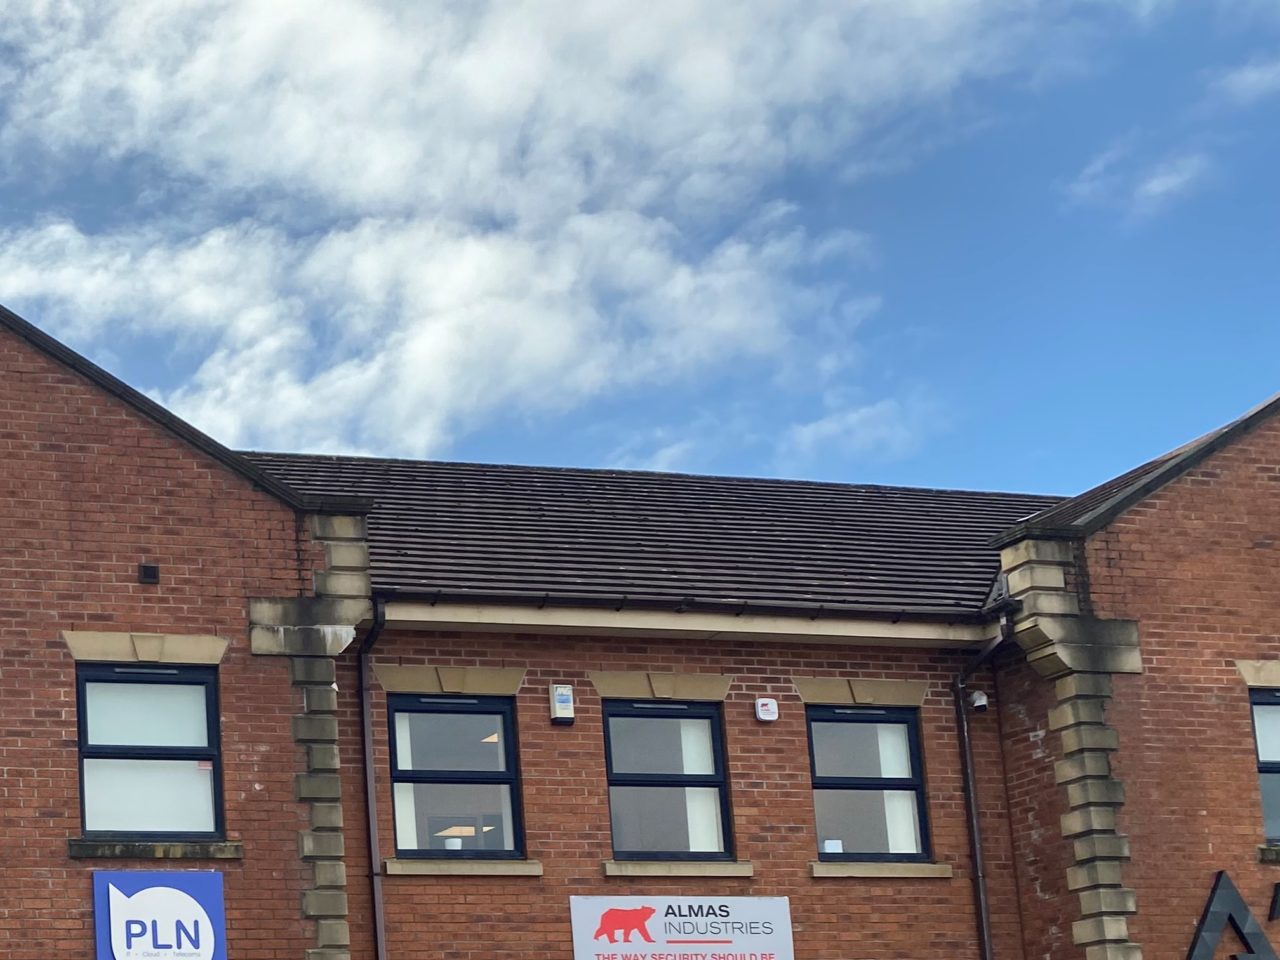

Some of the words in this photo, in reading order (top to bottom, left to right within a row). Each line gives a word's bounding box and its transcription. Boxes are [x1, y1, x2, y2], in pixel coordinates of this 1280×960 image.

[664, 904, 731, 918] ALMAS
[125, 919, 200, 950] PLN
[664, 921, 774, 935] INDUSTRIES
